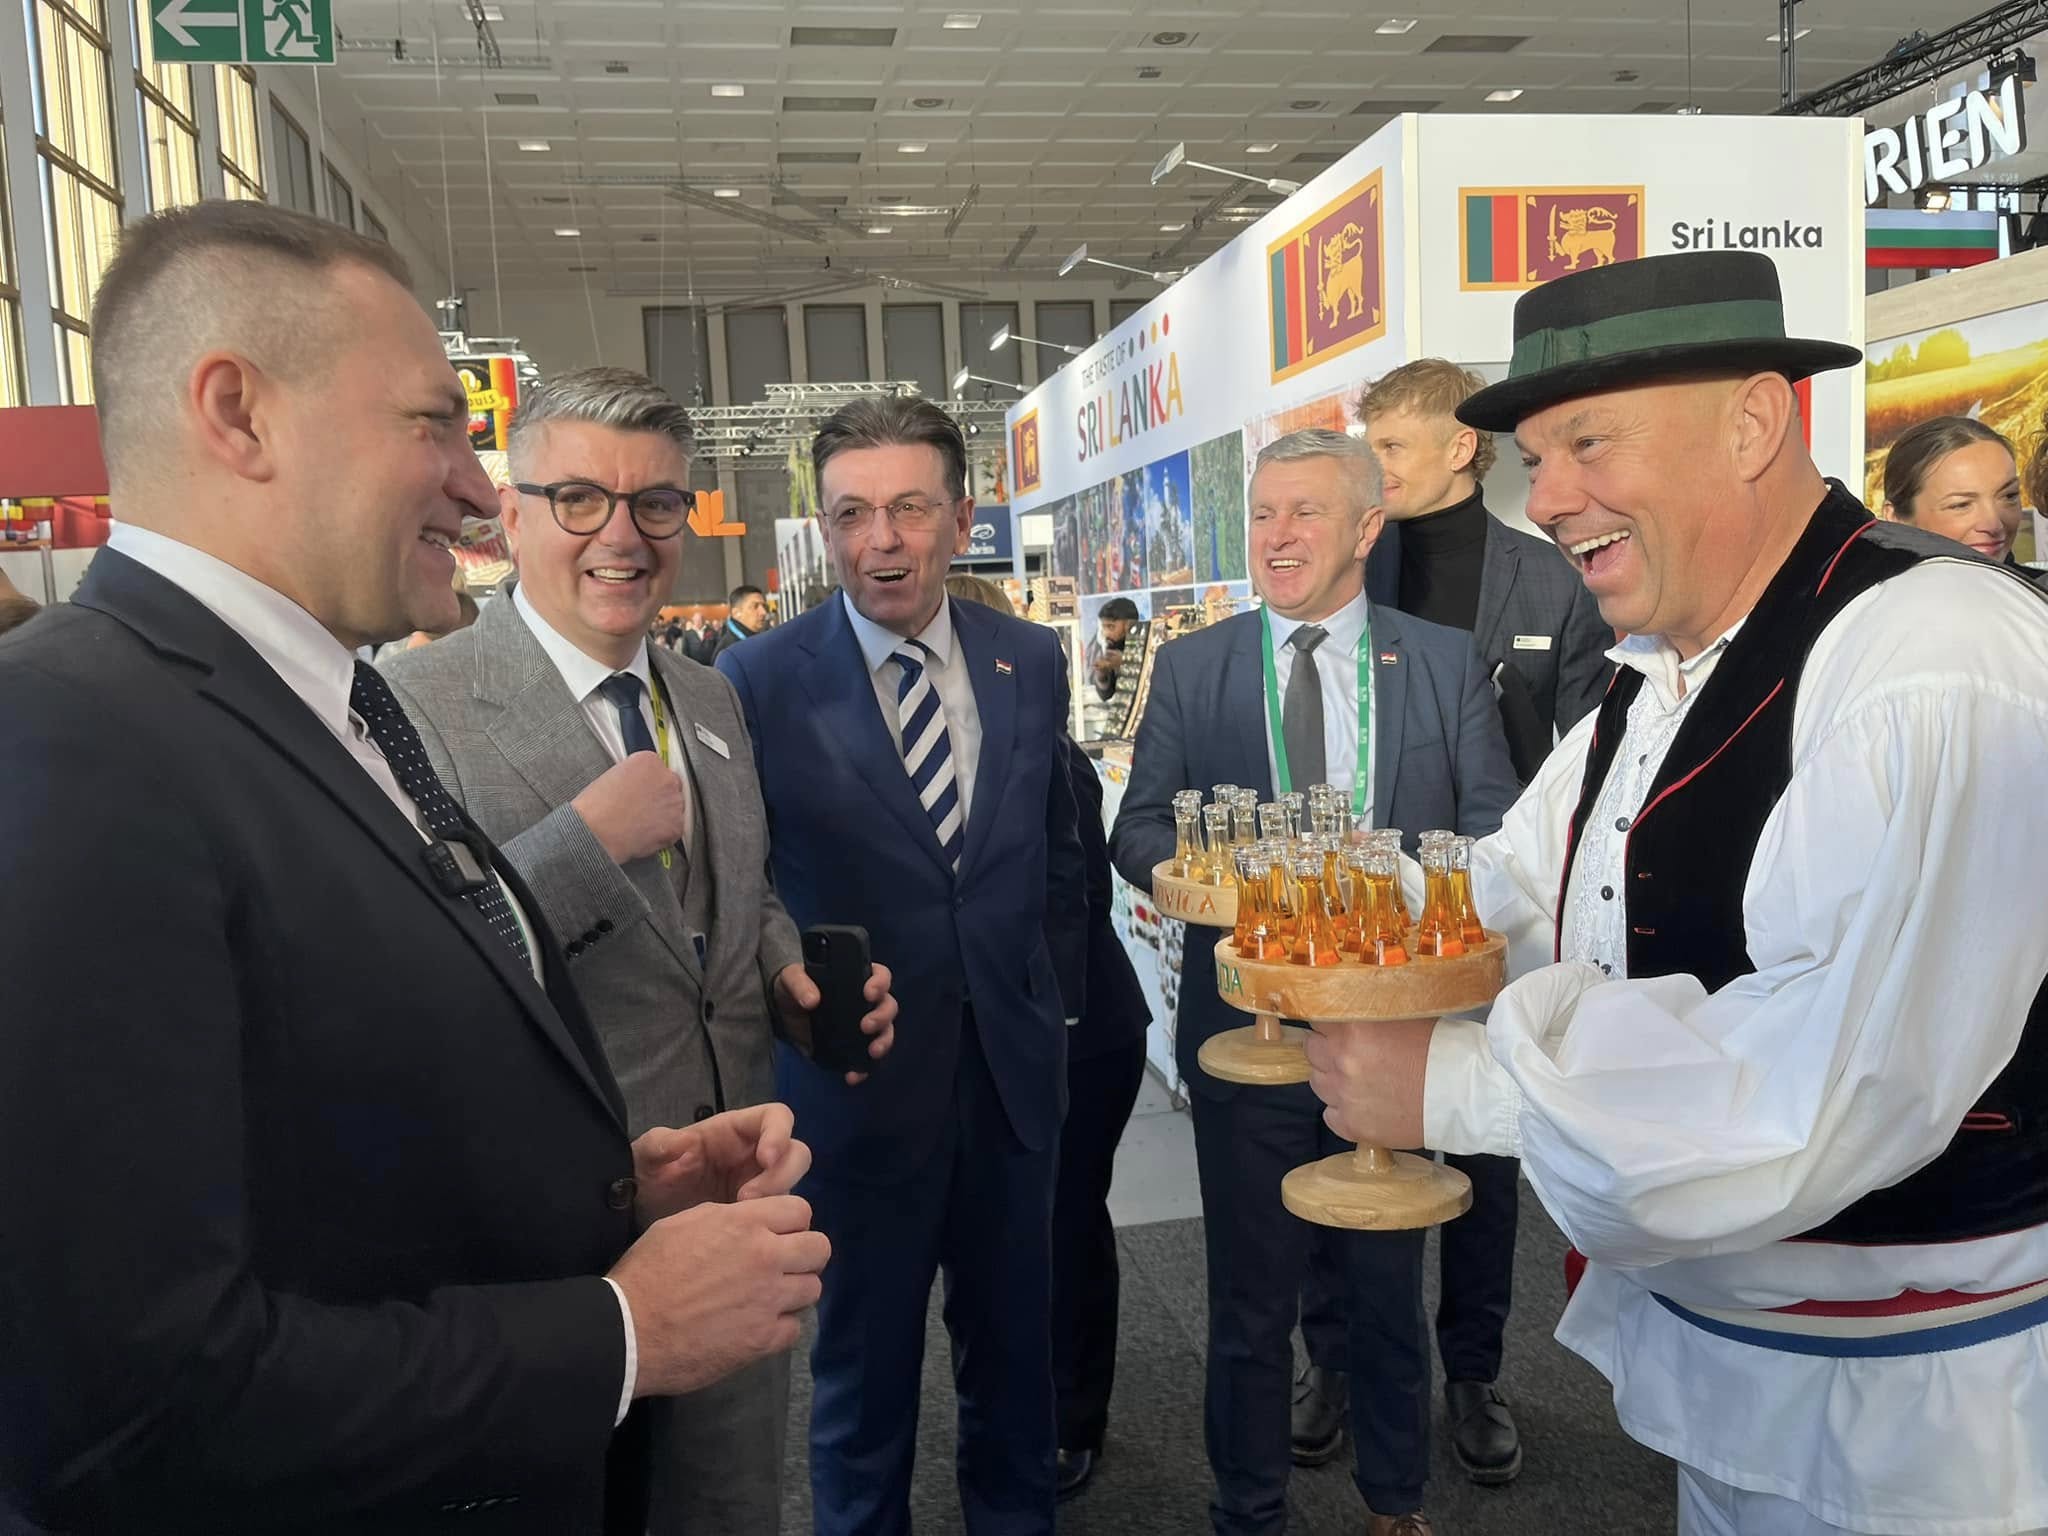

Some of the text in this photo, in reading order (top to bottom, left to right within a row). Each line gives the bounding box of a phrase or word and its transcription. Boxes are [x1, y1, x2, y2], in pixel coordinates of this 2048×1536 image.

[1864, 74, 2027, 205] RIEN
[1672, 218, 1823, 249] Sri Lanka
[1081, 341, 1126, 389] THE TASTE OF
[1078, 352, 1184, 462] SRI LANKA
